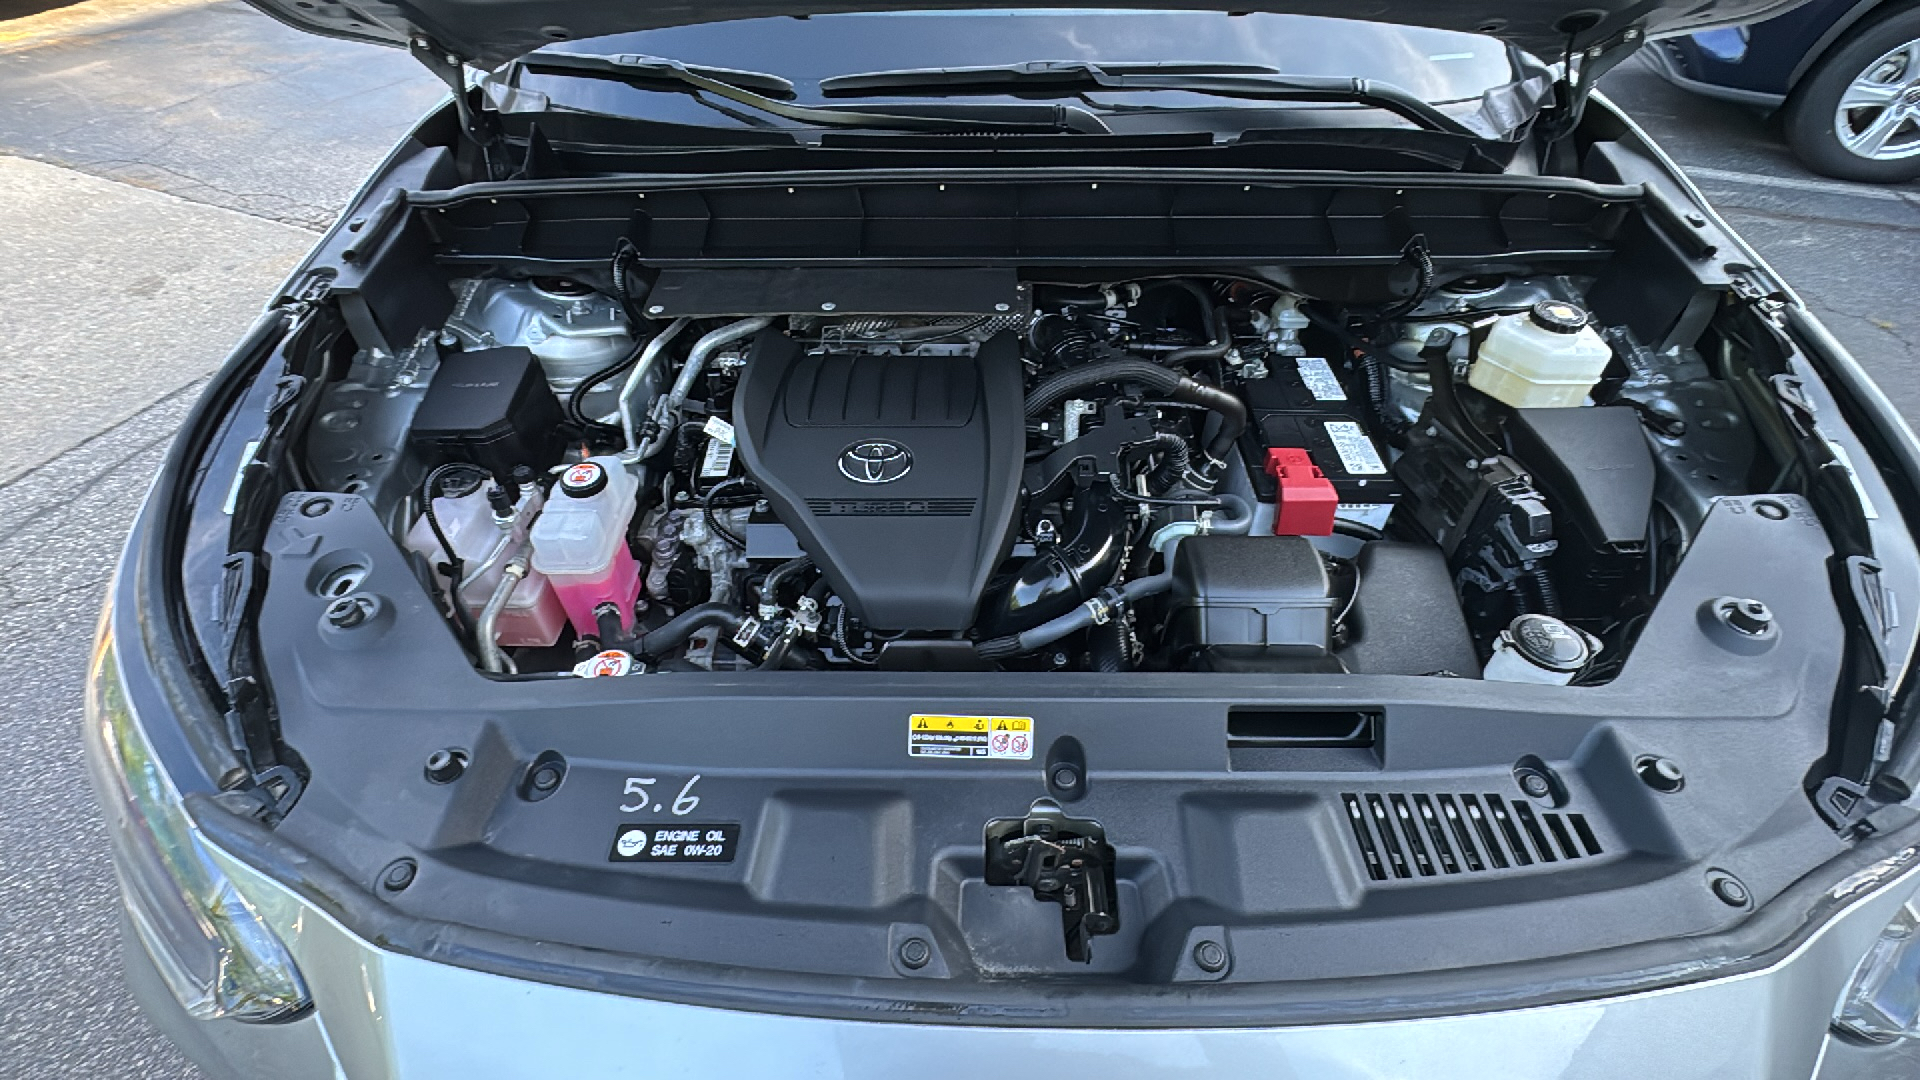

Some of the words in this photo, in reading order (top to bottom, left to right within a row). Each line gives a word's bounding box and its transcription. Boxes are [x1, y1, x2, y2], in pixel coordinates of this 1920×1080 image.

[833, 500, 927, 514] TURBO
[619, 774, 701, 816] 5.6
[654, 830, 700, 842] ENGINE
[705, 830, 726, 842] OIL
[650, 844, 678, 856] SAE
[684, 844, 723, 856] 0W-20
